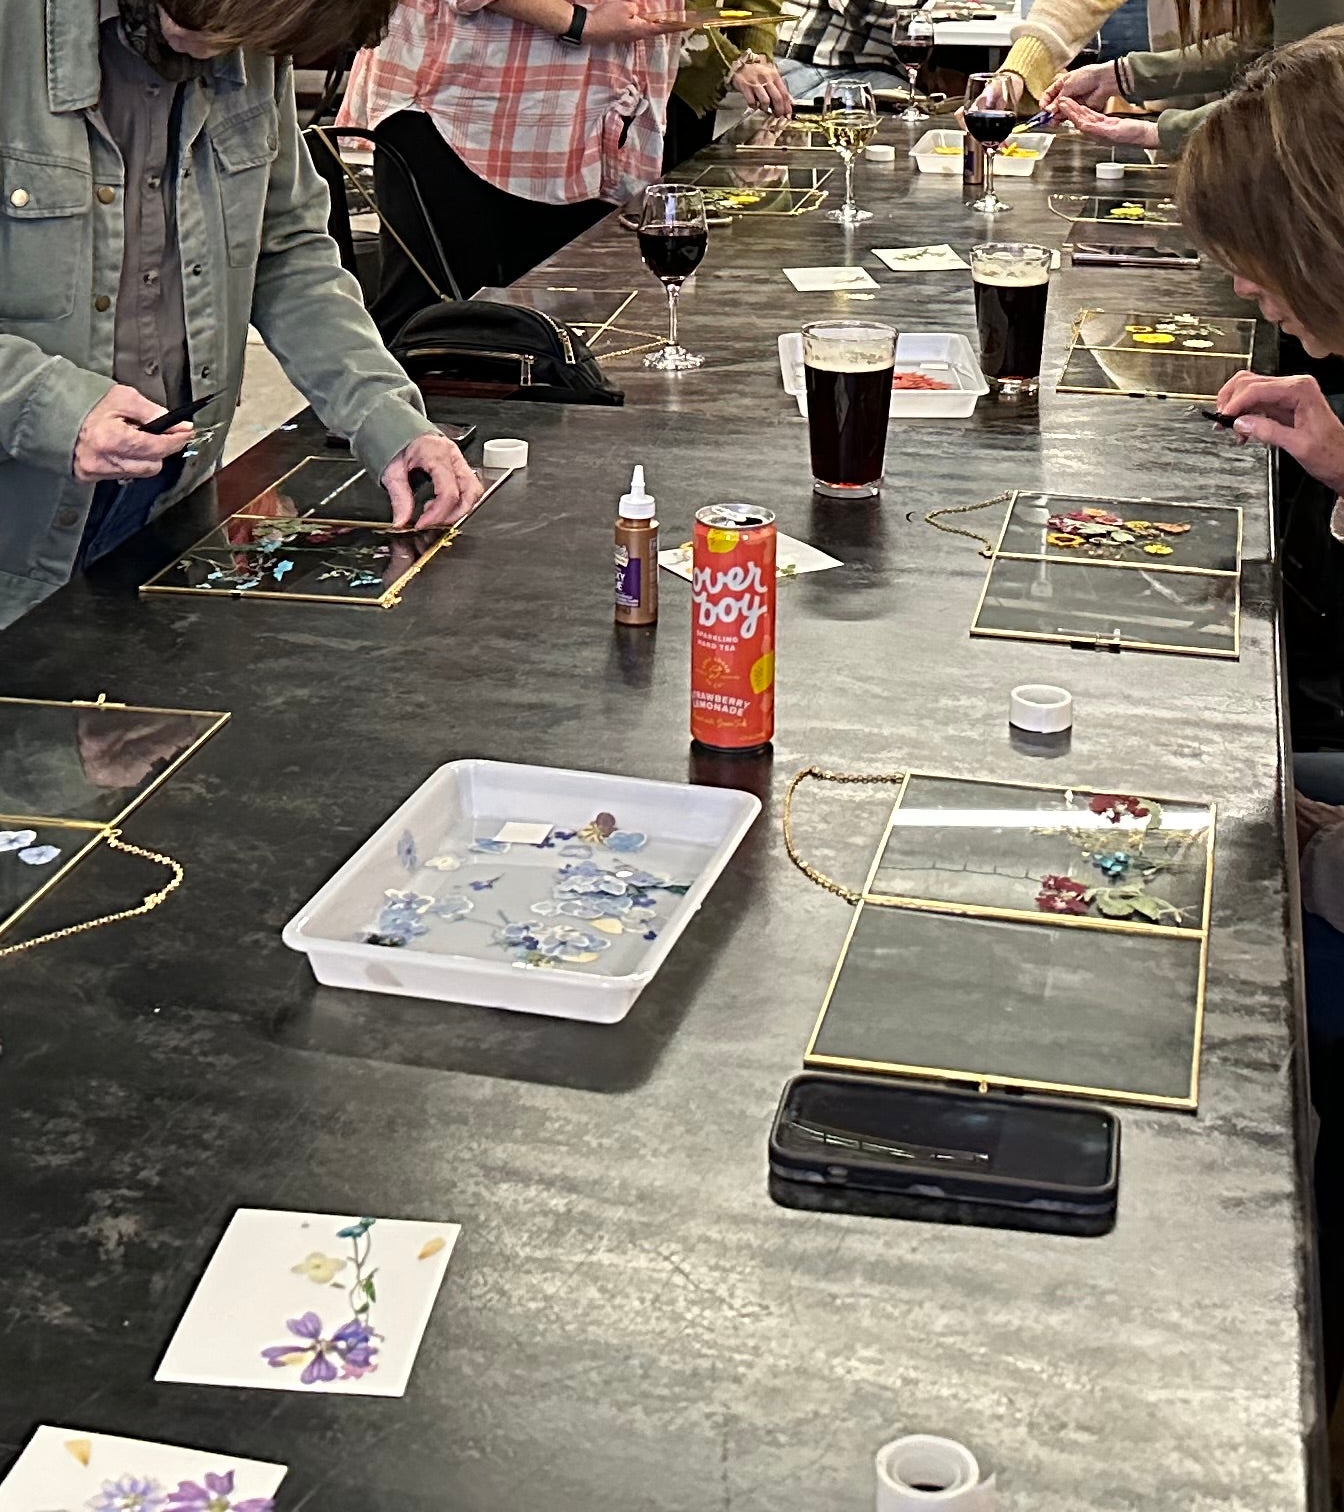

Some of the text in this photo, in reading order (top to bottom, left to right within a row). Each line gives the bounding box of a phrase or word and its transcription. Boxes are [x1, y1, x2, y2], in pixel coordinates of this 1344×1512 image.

[693, 561, 768, 594] over
[694, 591, 768, 639] boy
[697, 629, 738, 643] SPARKLING
[720, 644, 736, 652] TEA
